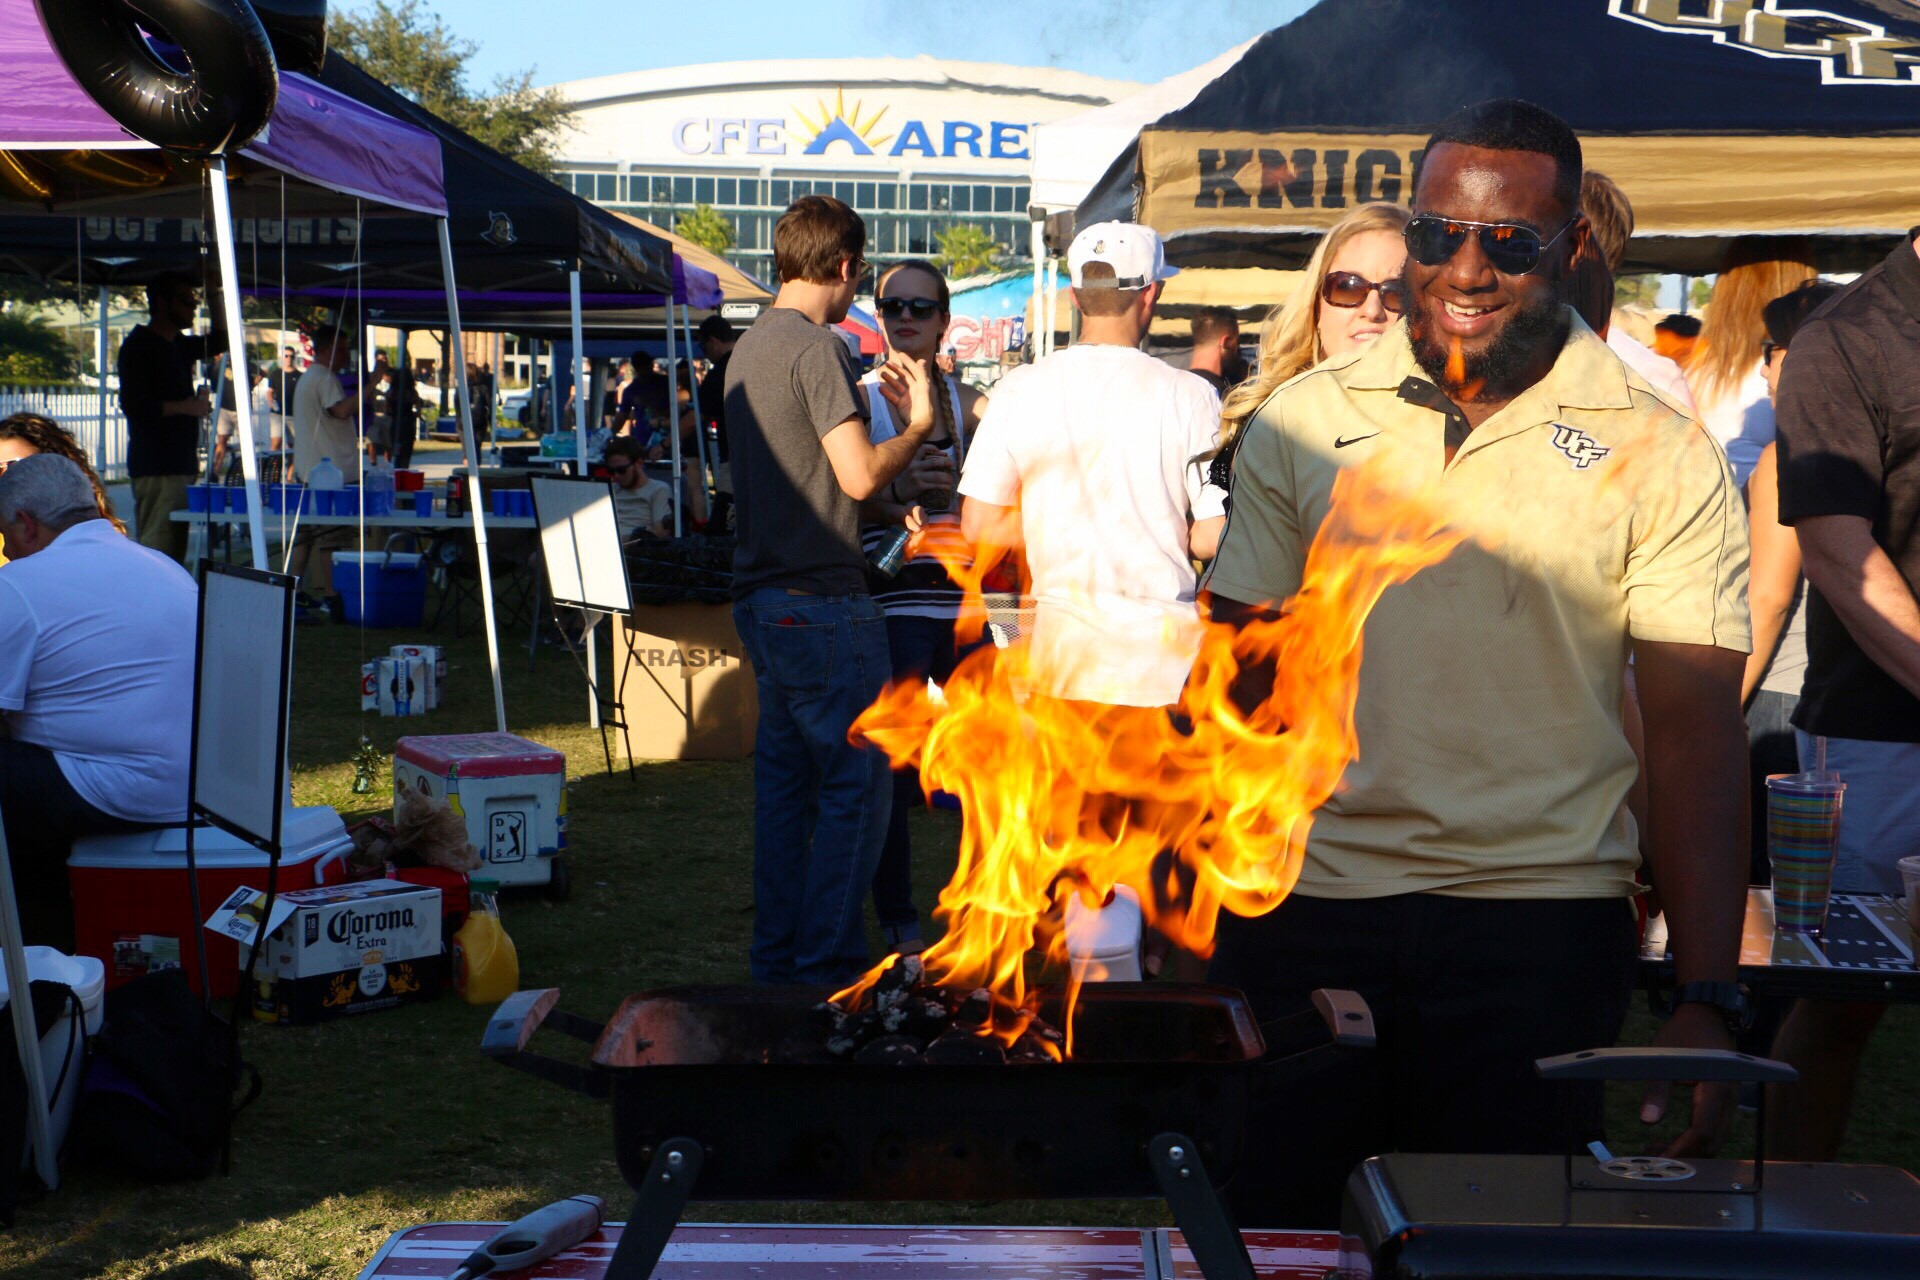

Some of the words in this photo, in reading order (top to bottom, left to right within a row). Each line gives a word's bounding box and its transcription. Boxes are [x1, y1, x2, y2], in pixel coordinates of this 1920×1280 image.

[672, 119, 787, 155] CFE
[888, 120, 1037, 160] ARE
[180, 217, 361, 245] KIGHTS
[1551, 424, 1611, 469] UCF
[632, 648, 728, 668] TRASH
[306, 917, 317, 930] 18
[327, 908, 415, 945] Corona
[357, 935, 387, 950] Extra
